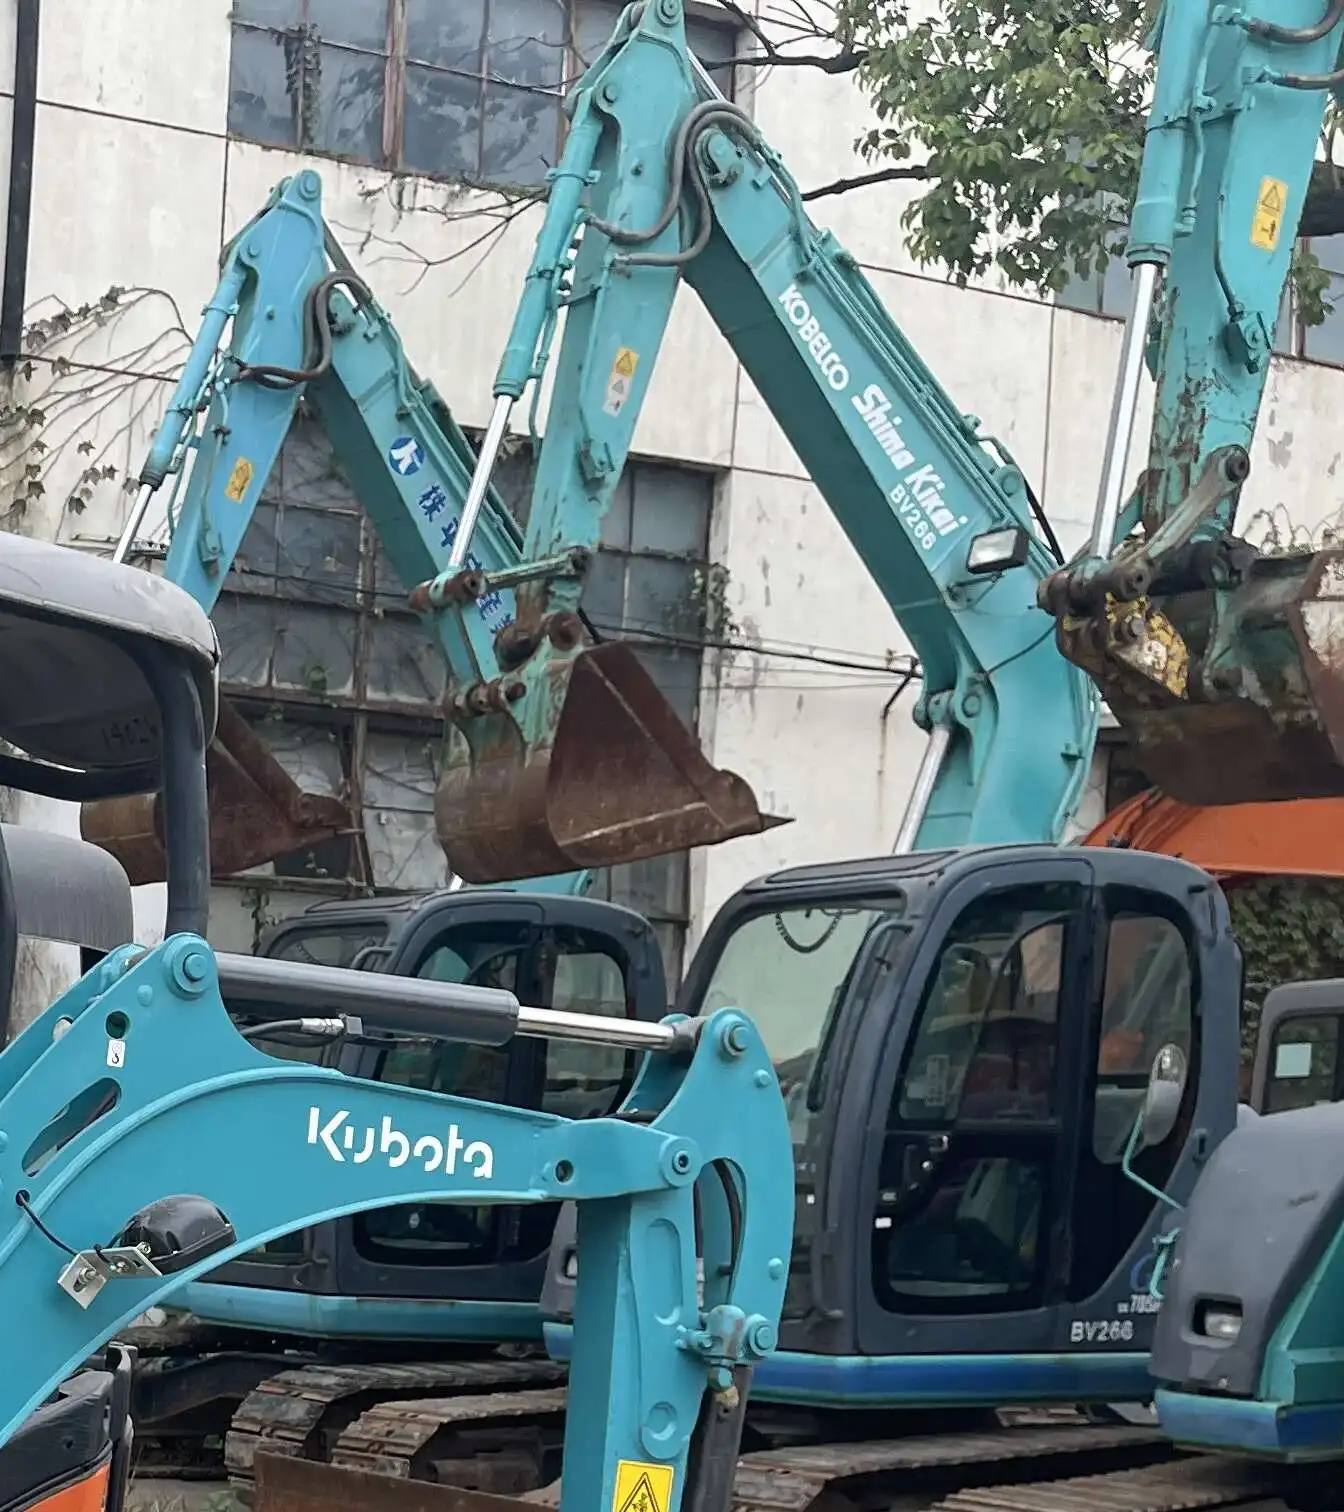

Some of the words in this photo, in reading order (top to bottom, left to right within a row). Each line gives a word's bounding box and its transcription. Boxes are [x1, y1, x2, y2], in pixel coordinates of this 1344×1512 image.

[778, 284, 849, 391] KOBELCO
[851, 384, 915, 470] Shima
[904, 464, 968, 536] Kikai
[307, 1105, 495, 1180] Kubota
